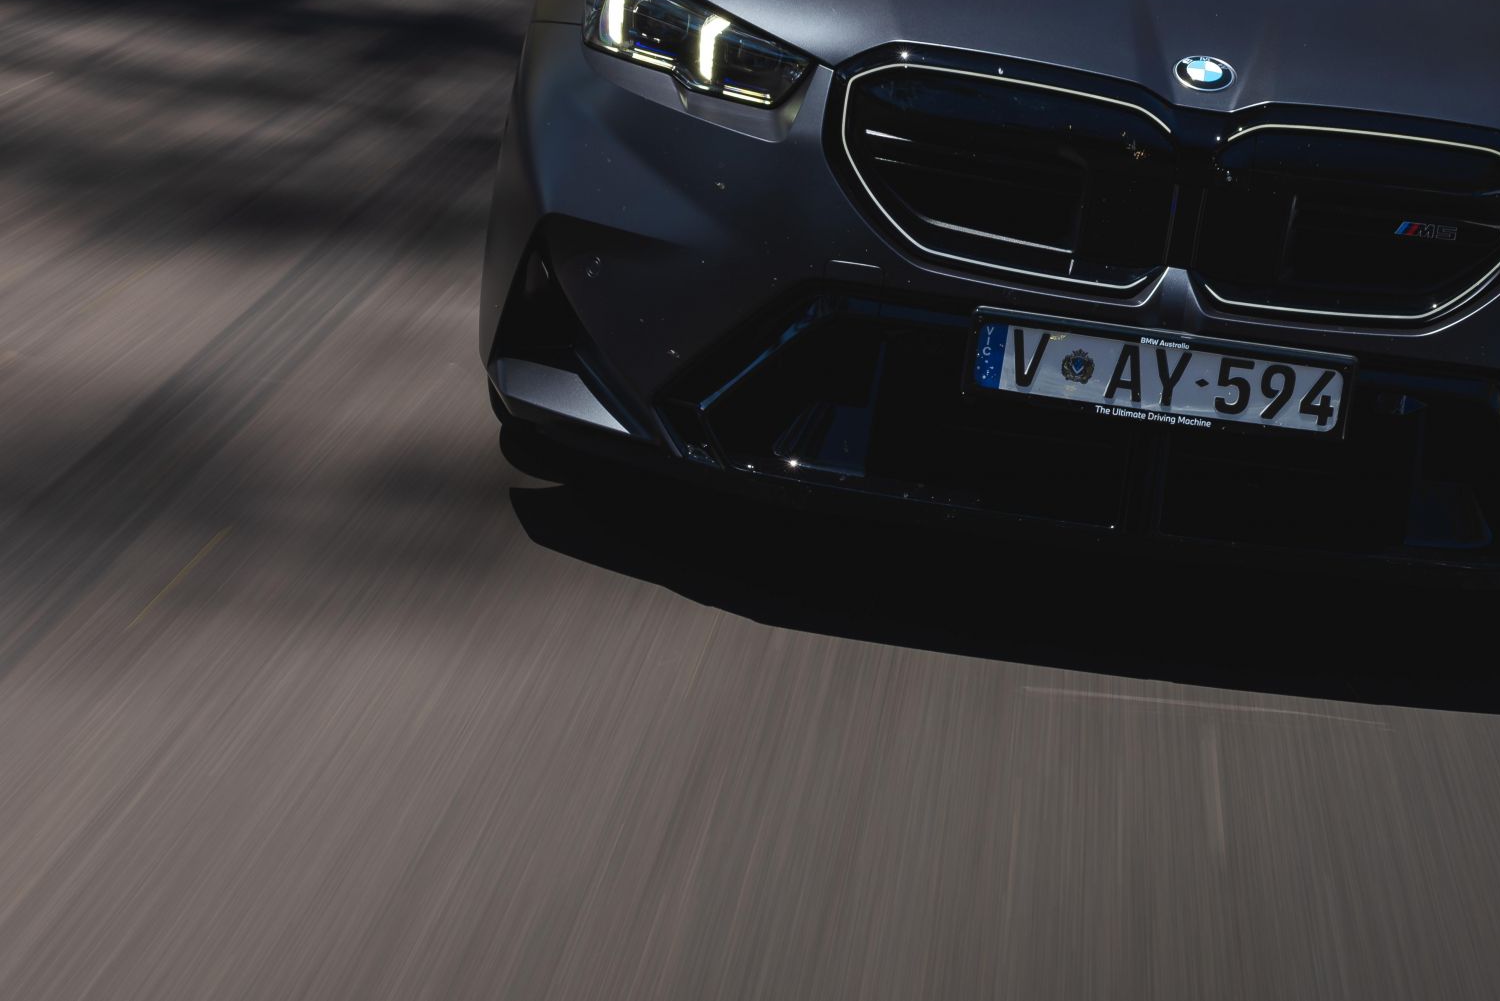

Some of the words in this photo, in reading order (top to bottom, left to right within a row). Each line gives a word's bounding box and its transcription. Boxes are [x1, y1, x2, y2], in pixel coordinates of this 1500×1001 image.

[982, 326, 996, 356] VIC
[1140, 336, 1159, 347] BMW
[1159, 339, 1190, 350] Australia
[1013, 329, 1050, 387] V
[1095, 404, 1111, 416] The
[1112, 407, 1147, 421] Ultimate
[1147, 412, 1176, 425] Driving
[1177, 415, 1212, 428] Machine
